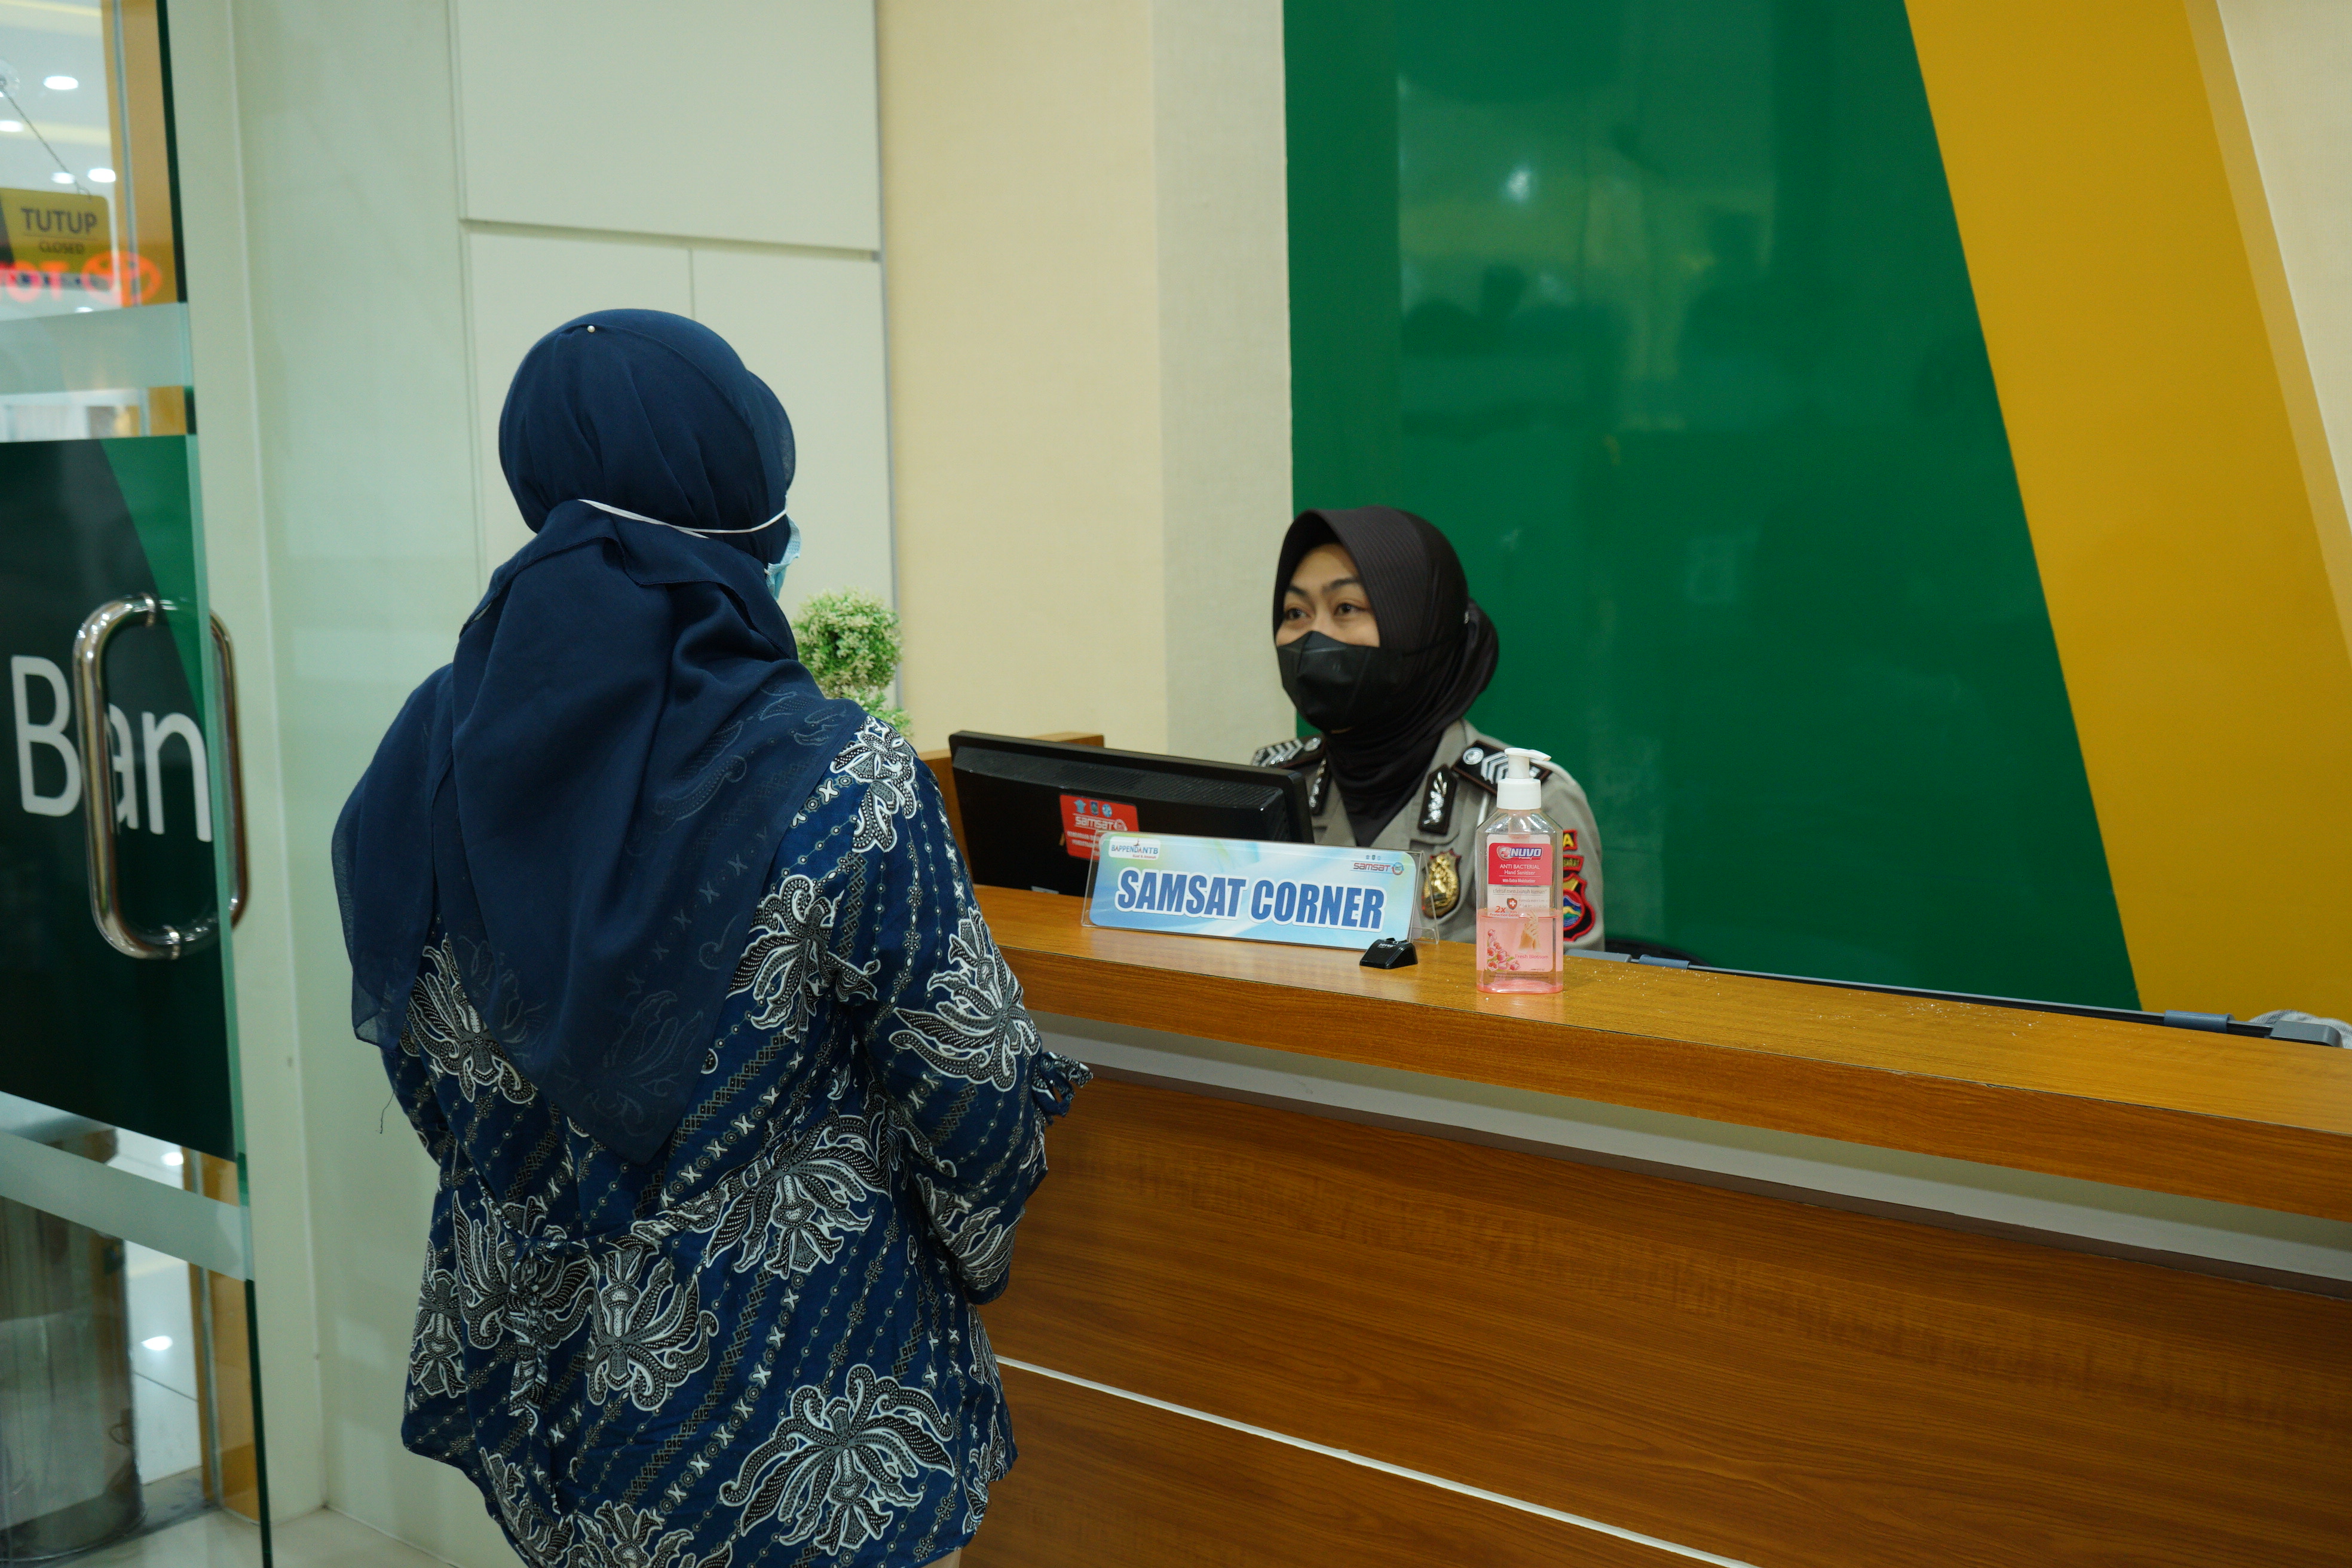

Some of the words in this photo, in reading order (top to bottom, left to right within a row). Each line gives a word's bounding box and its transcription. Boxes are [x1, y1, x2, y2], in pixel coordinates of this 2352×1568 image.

[21, 207, 97, 234] TUTUP
[39, 241, 85, 254] CLOSED
[1511, 848, 1542, 857] NUVO
[1119, 869, 1247, 917] SAMSAT
[1251, 879, 1385, 930] CORNER
